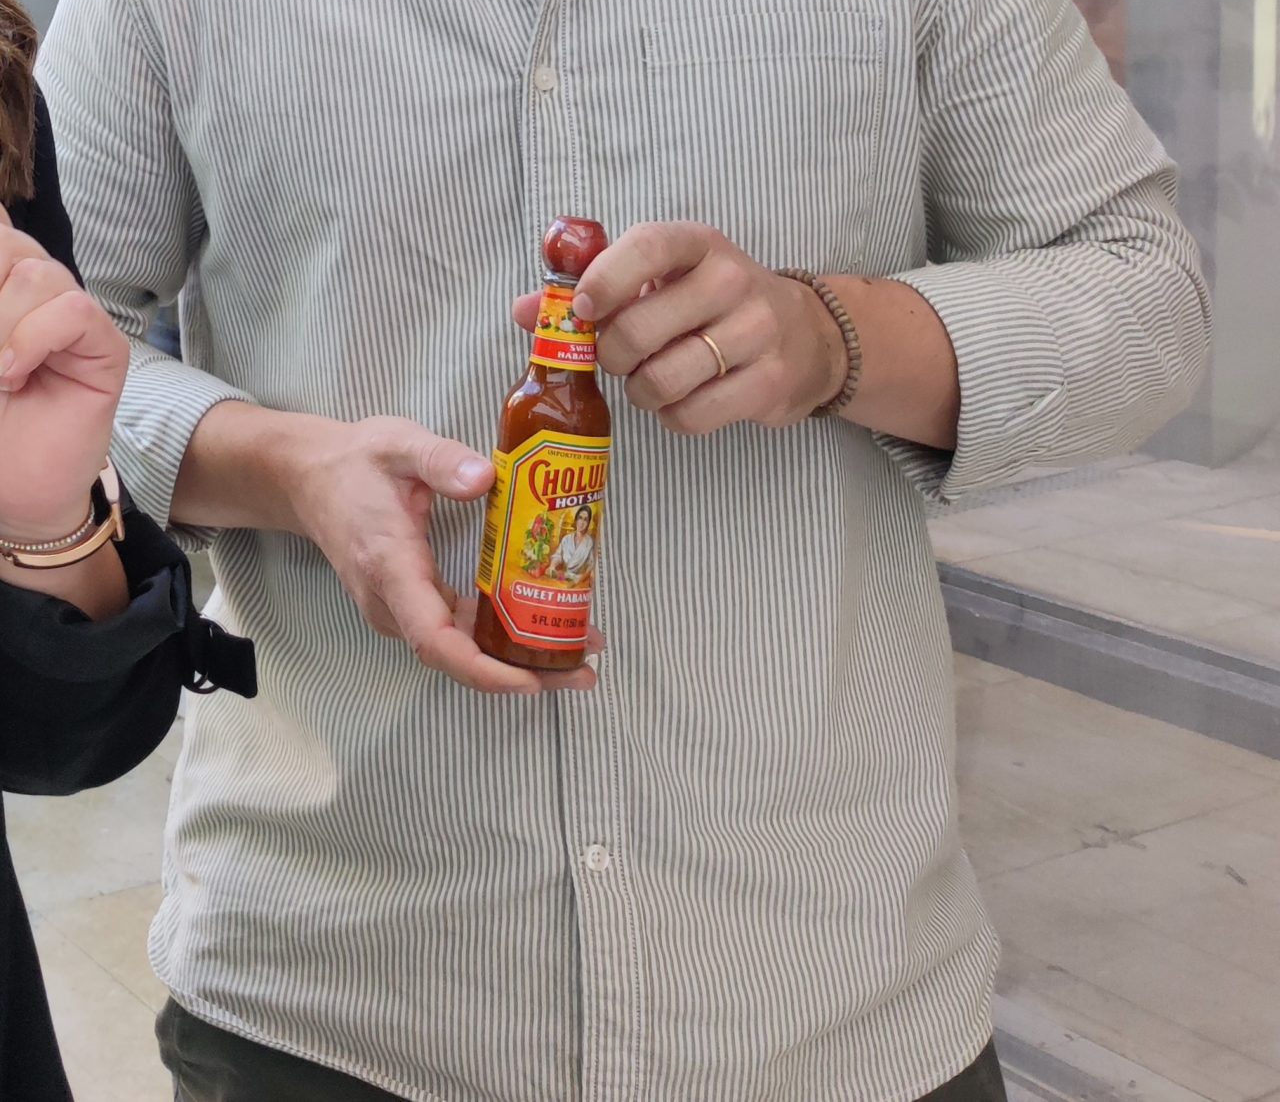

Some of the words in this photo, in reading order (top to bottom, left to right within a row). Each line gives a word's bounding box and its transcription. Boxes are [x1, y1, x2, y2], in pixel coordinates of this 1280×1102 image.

[555, 496, 584, 509] HOT
[515, 585, 554, 601] SWEET
[531, 614, 537, 624] 5
[539, 616, 548, 626] FL
[551, 617, 561, 628] OZ
